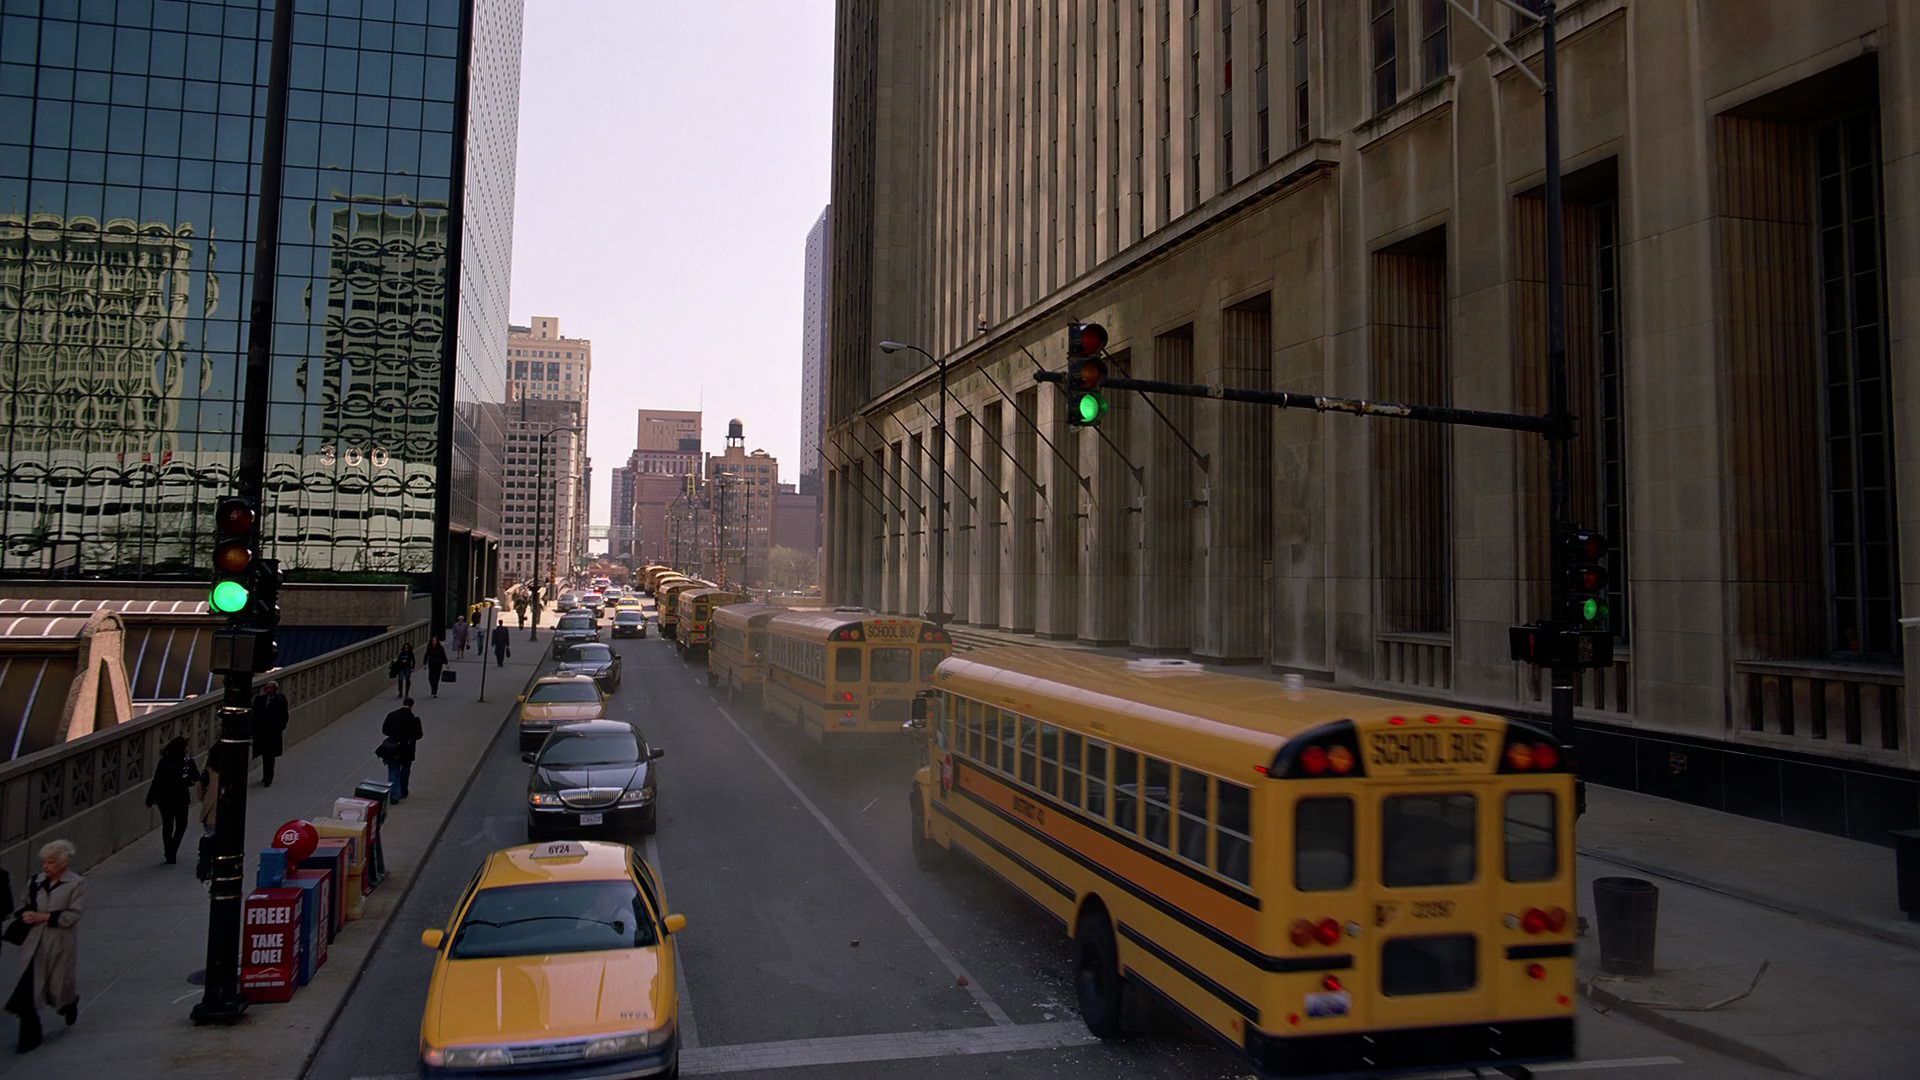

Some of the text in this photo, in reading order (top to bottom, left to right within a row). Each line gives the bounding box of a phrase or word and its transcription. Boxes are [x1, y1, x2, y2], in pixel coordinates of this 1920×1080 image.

[320, 444, 389, 467] 300
[868, 625, 914, 638] SCHOOL BUS
[1372, 732, 1488, 765] SCHOOL BUS
[281, 832, 299, 842] FREE
[548, 845, 570, 854] 6Y24
[247, 907, 290, 924] FREE!
[251, 933, 284, 948] TAKE
[251, 949, 282, 964] ONE!
